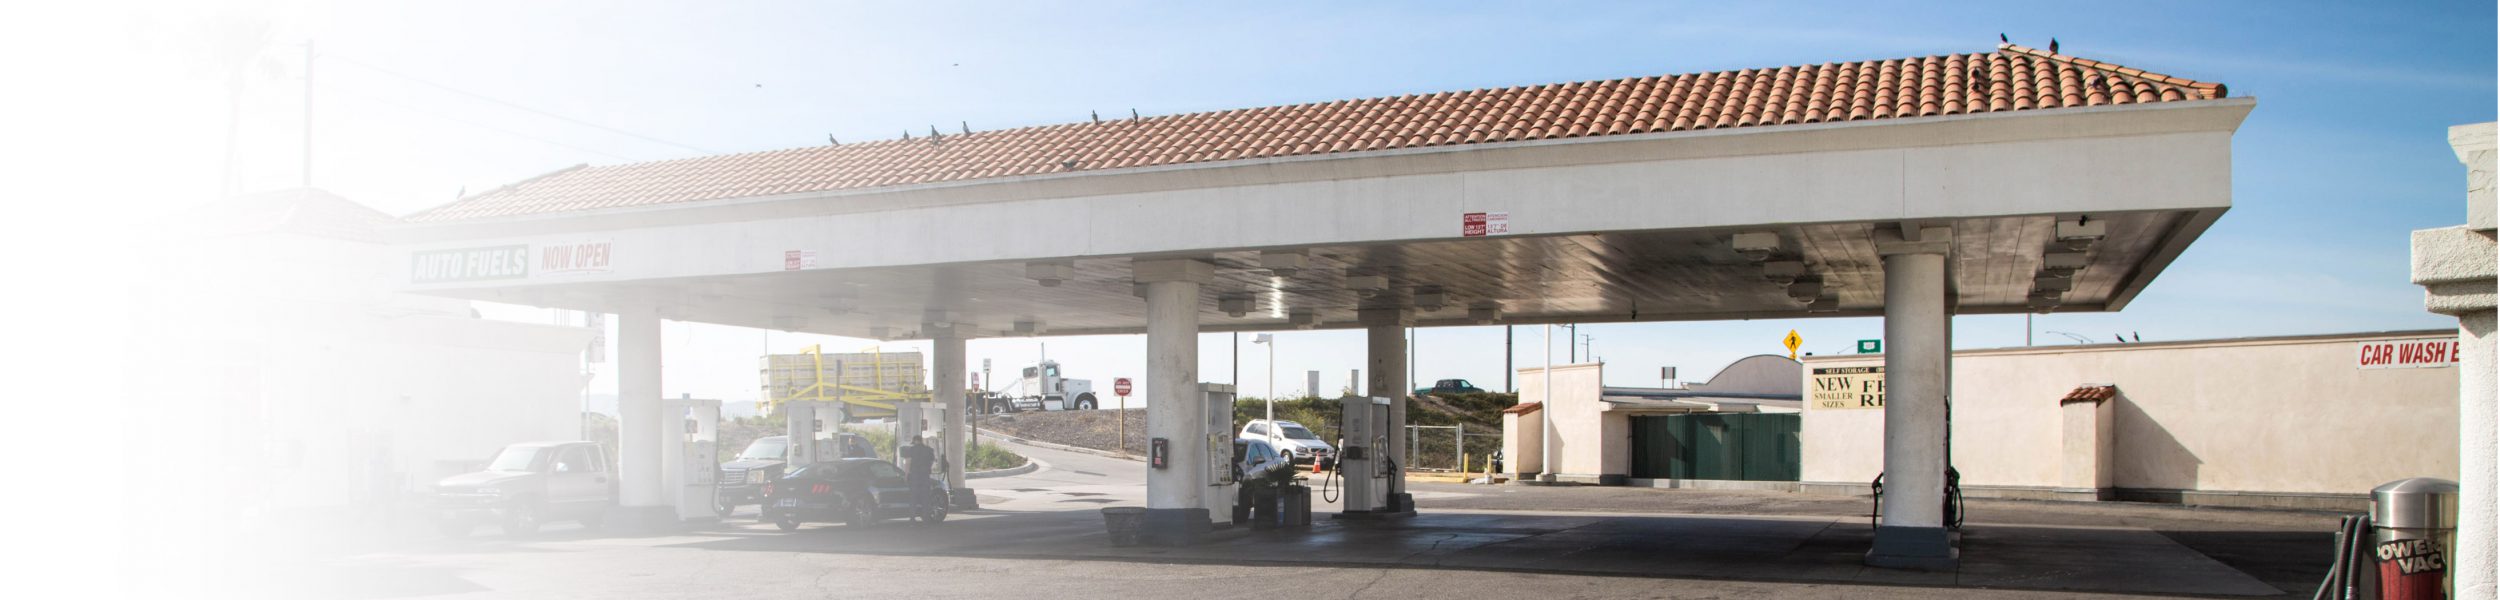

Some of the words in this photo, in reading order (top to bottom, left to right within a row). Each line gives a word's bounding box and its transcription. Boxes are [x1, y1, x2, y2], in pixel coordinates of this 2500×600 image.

[415, 253, 463, 280] AUTO
[466, 248, 526, 278] FUELS
[542, 245, 574, 270] NOW
[575, 242, 611, 269] OPEN
[2361, 344, 2394, 366] CAR
[2399, 341, 2447, 364] WASH
[1815, 376, 1854, 391] NEW
[1814, 392, 1853, 400] SMALLER
[1822, 400, 1845, 408] SIZES
[2398, 553, 2442, 574] VAC
